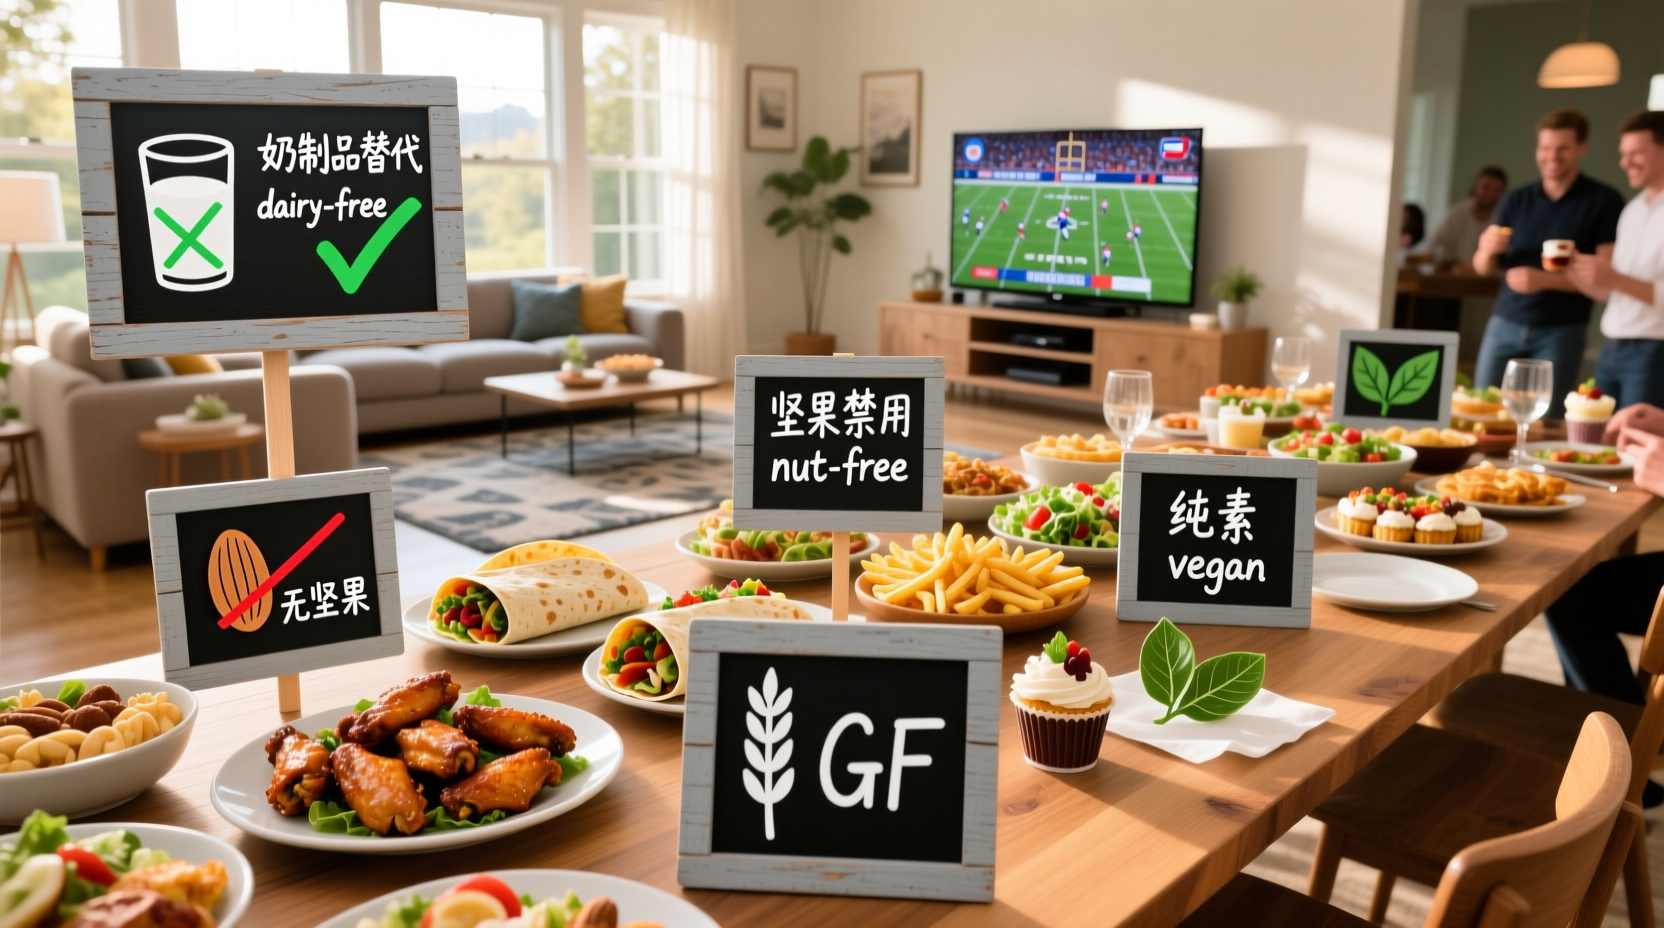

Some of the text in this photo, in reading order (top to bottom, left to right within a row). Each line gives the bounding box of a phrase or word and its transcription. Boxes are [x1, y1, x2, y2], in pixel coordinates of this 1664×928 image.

[258, 130, 423, 175] 奶制品替代
[257, 187, 388, 229] dairy-free
[770, 388, 911, 439] 坚果禁用
[771, 446, 909, 486] nut-free
[1169, 487, 1256, 545] 纯素
[1168, 555, 1266, 595] vegan
[281, 576, 370, 624] 无坚果
[819, 712, 946, 812] GF
